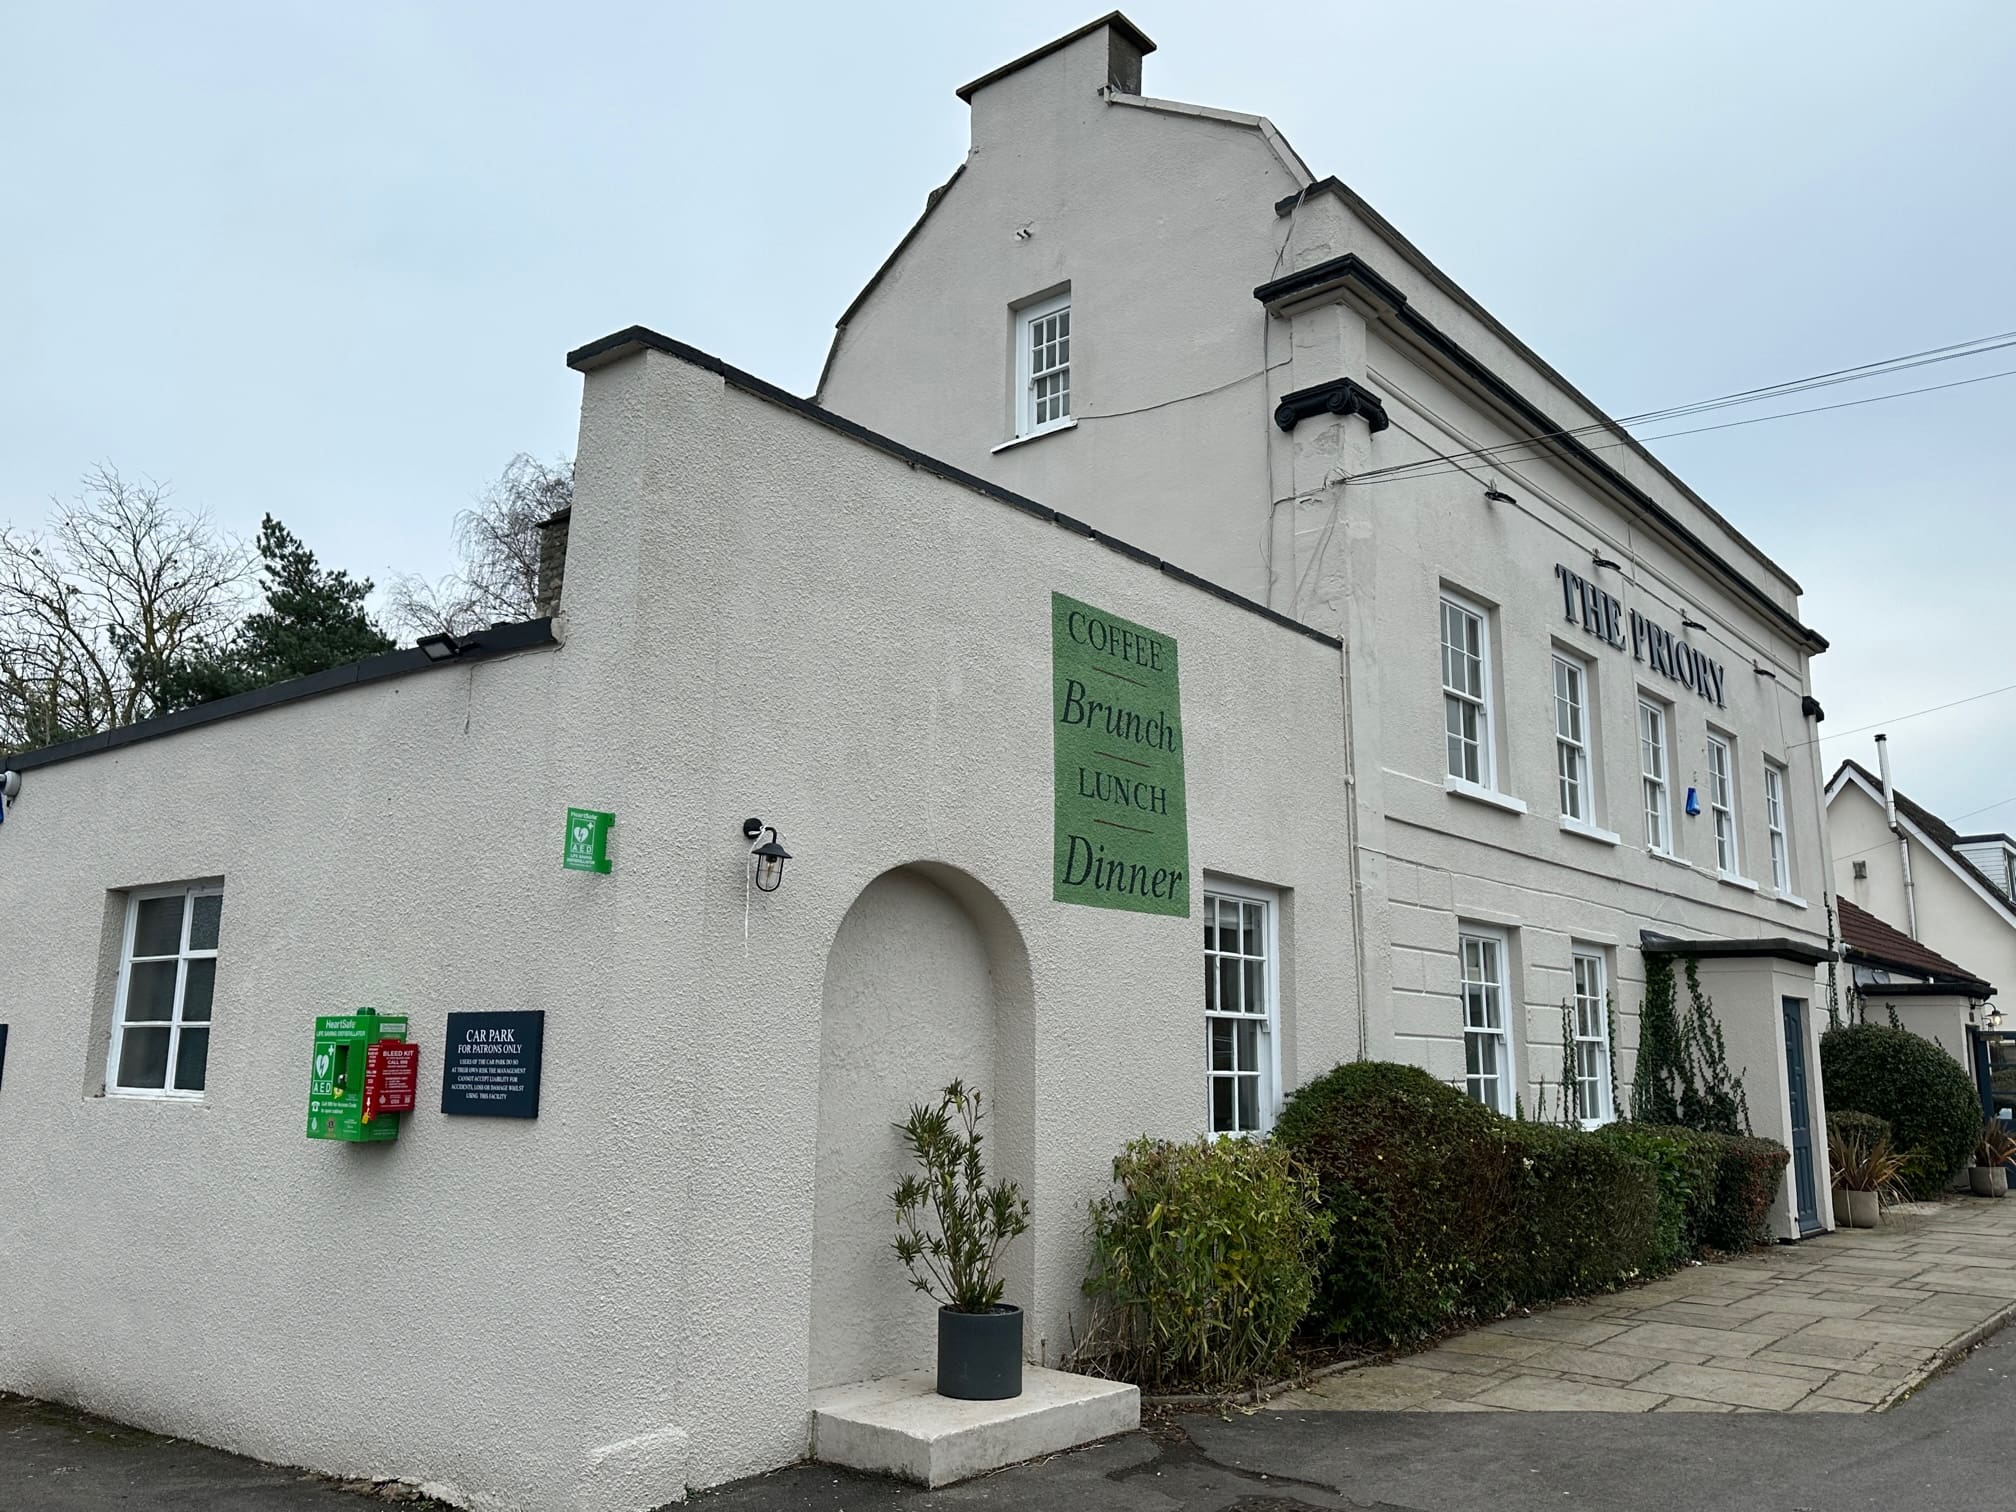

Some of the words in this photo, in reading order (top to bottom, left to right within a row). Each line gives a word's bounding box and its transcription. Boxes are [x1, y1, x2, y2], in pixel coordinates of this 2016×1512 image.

[1068, 611, 1163, 672] COFFEE
[1555, 563, 1627, 651] THE
[1629, 608, 1727, 710] PRIORY
[1060, 678, 1177, 753] Brunch
[1078, 767, 1168, 816] LUNCH
[1061, 834, 1182, 900] Dinner
[325, 1018, 357, 1029] HeartSafe
[466, 1029, 487, 1042] CAR
[488, 1028, 515, 1042] PARK
[457, 1044, 472, 1054] FOR
[472, 1044, 502, 1054] PATRONS
[502, 1044, 523, 1054] ONLY
[312, 1082, 331, 1093] AED
